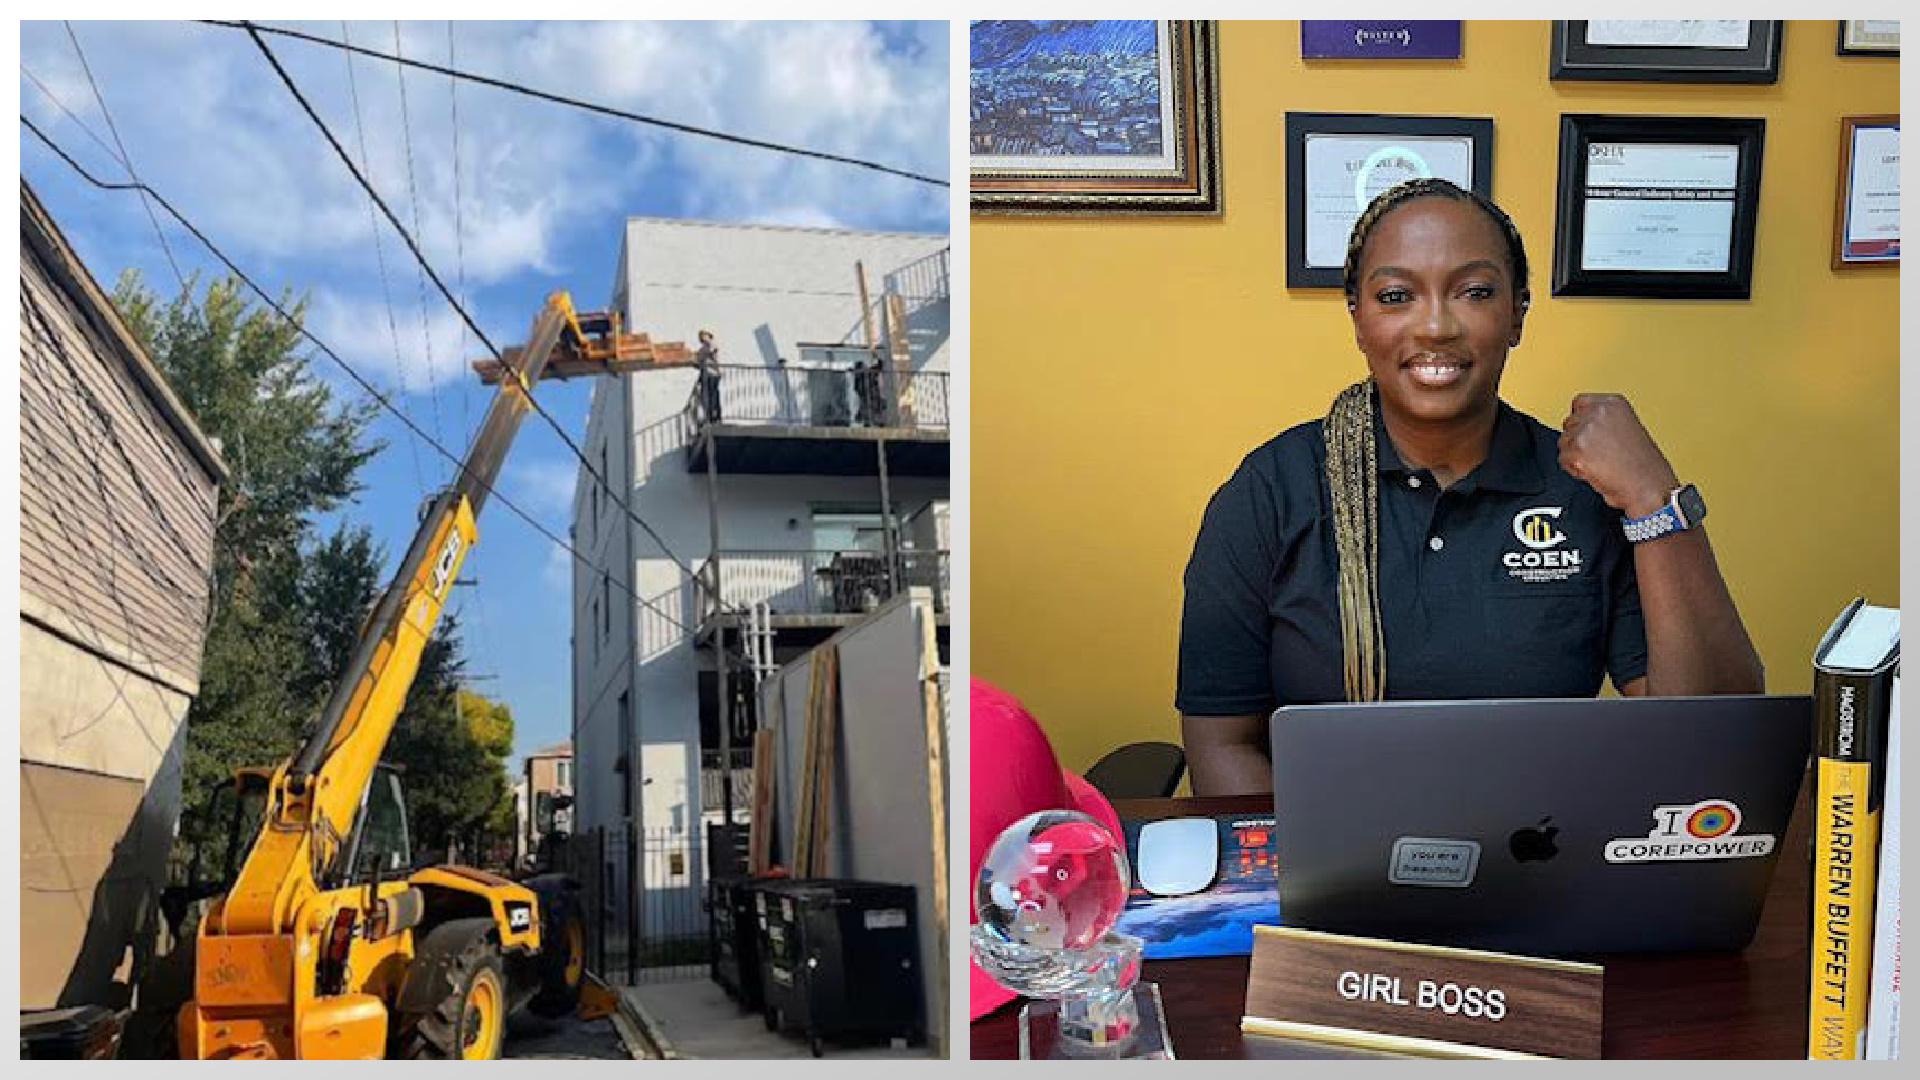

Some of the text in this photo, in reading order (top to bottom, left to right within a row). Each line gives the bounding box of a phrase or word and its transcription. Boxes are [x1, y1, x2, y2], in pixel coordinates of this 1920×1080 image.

[433, 527, 461, 598] JCB
[1503, 549, 1581, 567] COEN
[1838, 686, 1855, 756] HAGSTROM
[1613, 840, 1767, 859] COREPOWER
[1661, 810, 1683, 837] I
[1829, 794, 1854, 898] WARREN
[1824, 902, 1850, 1011] BUFFETT
[1338, 971, 1507, 1021] GIRL BOSS
